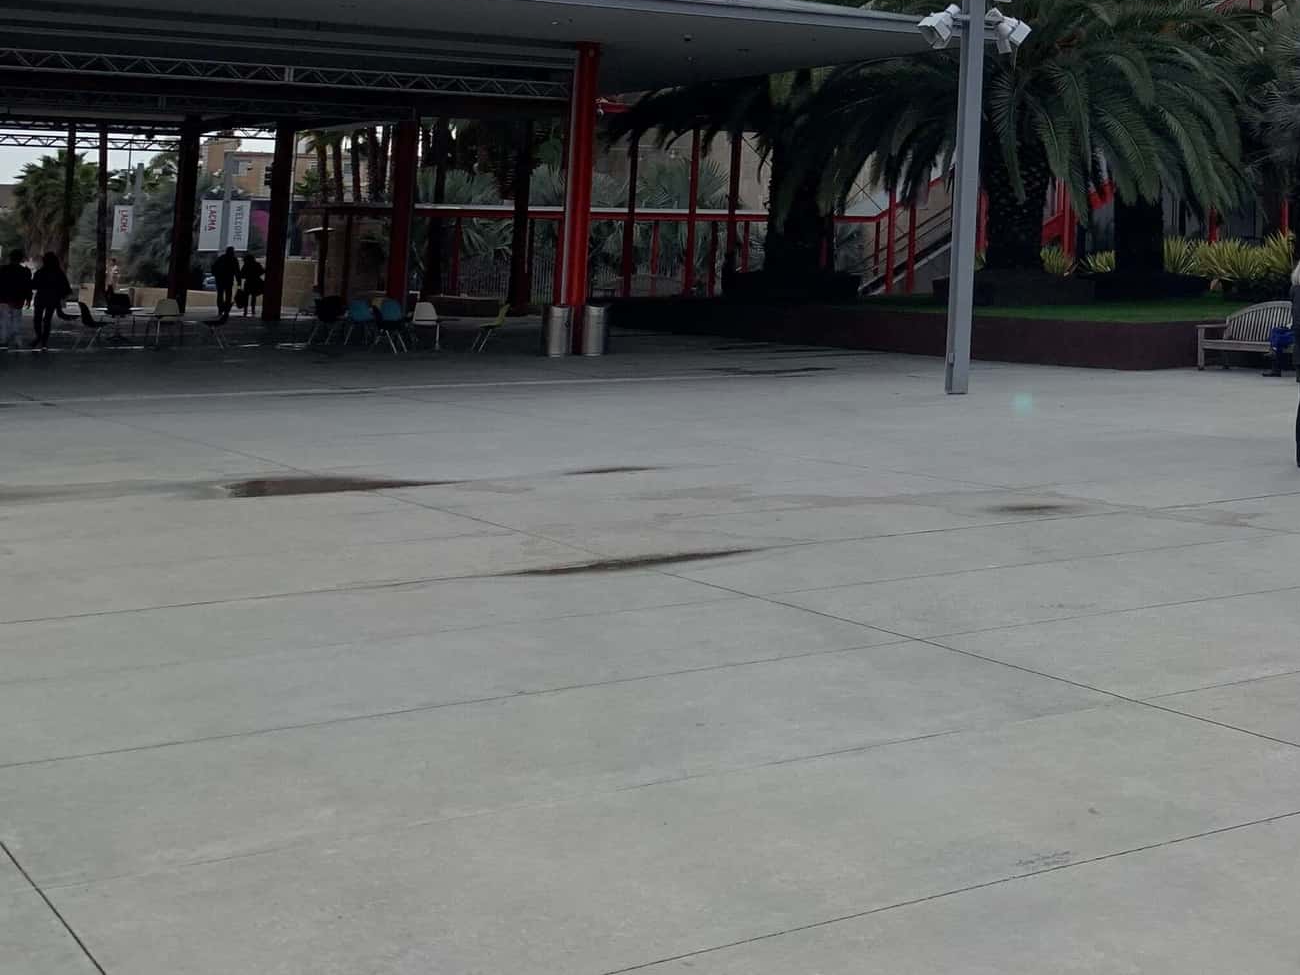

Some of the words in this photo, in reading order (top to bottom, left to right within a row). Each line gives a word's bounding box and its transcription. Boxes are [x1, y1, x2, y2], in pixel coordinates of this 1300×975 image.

[119, 209, 129, 233] LACMA
[207, 205, 217, 231] LACMA
[232, 204, 242, 241] WELCOME
